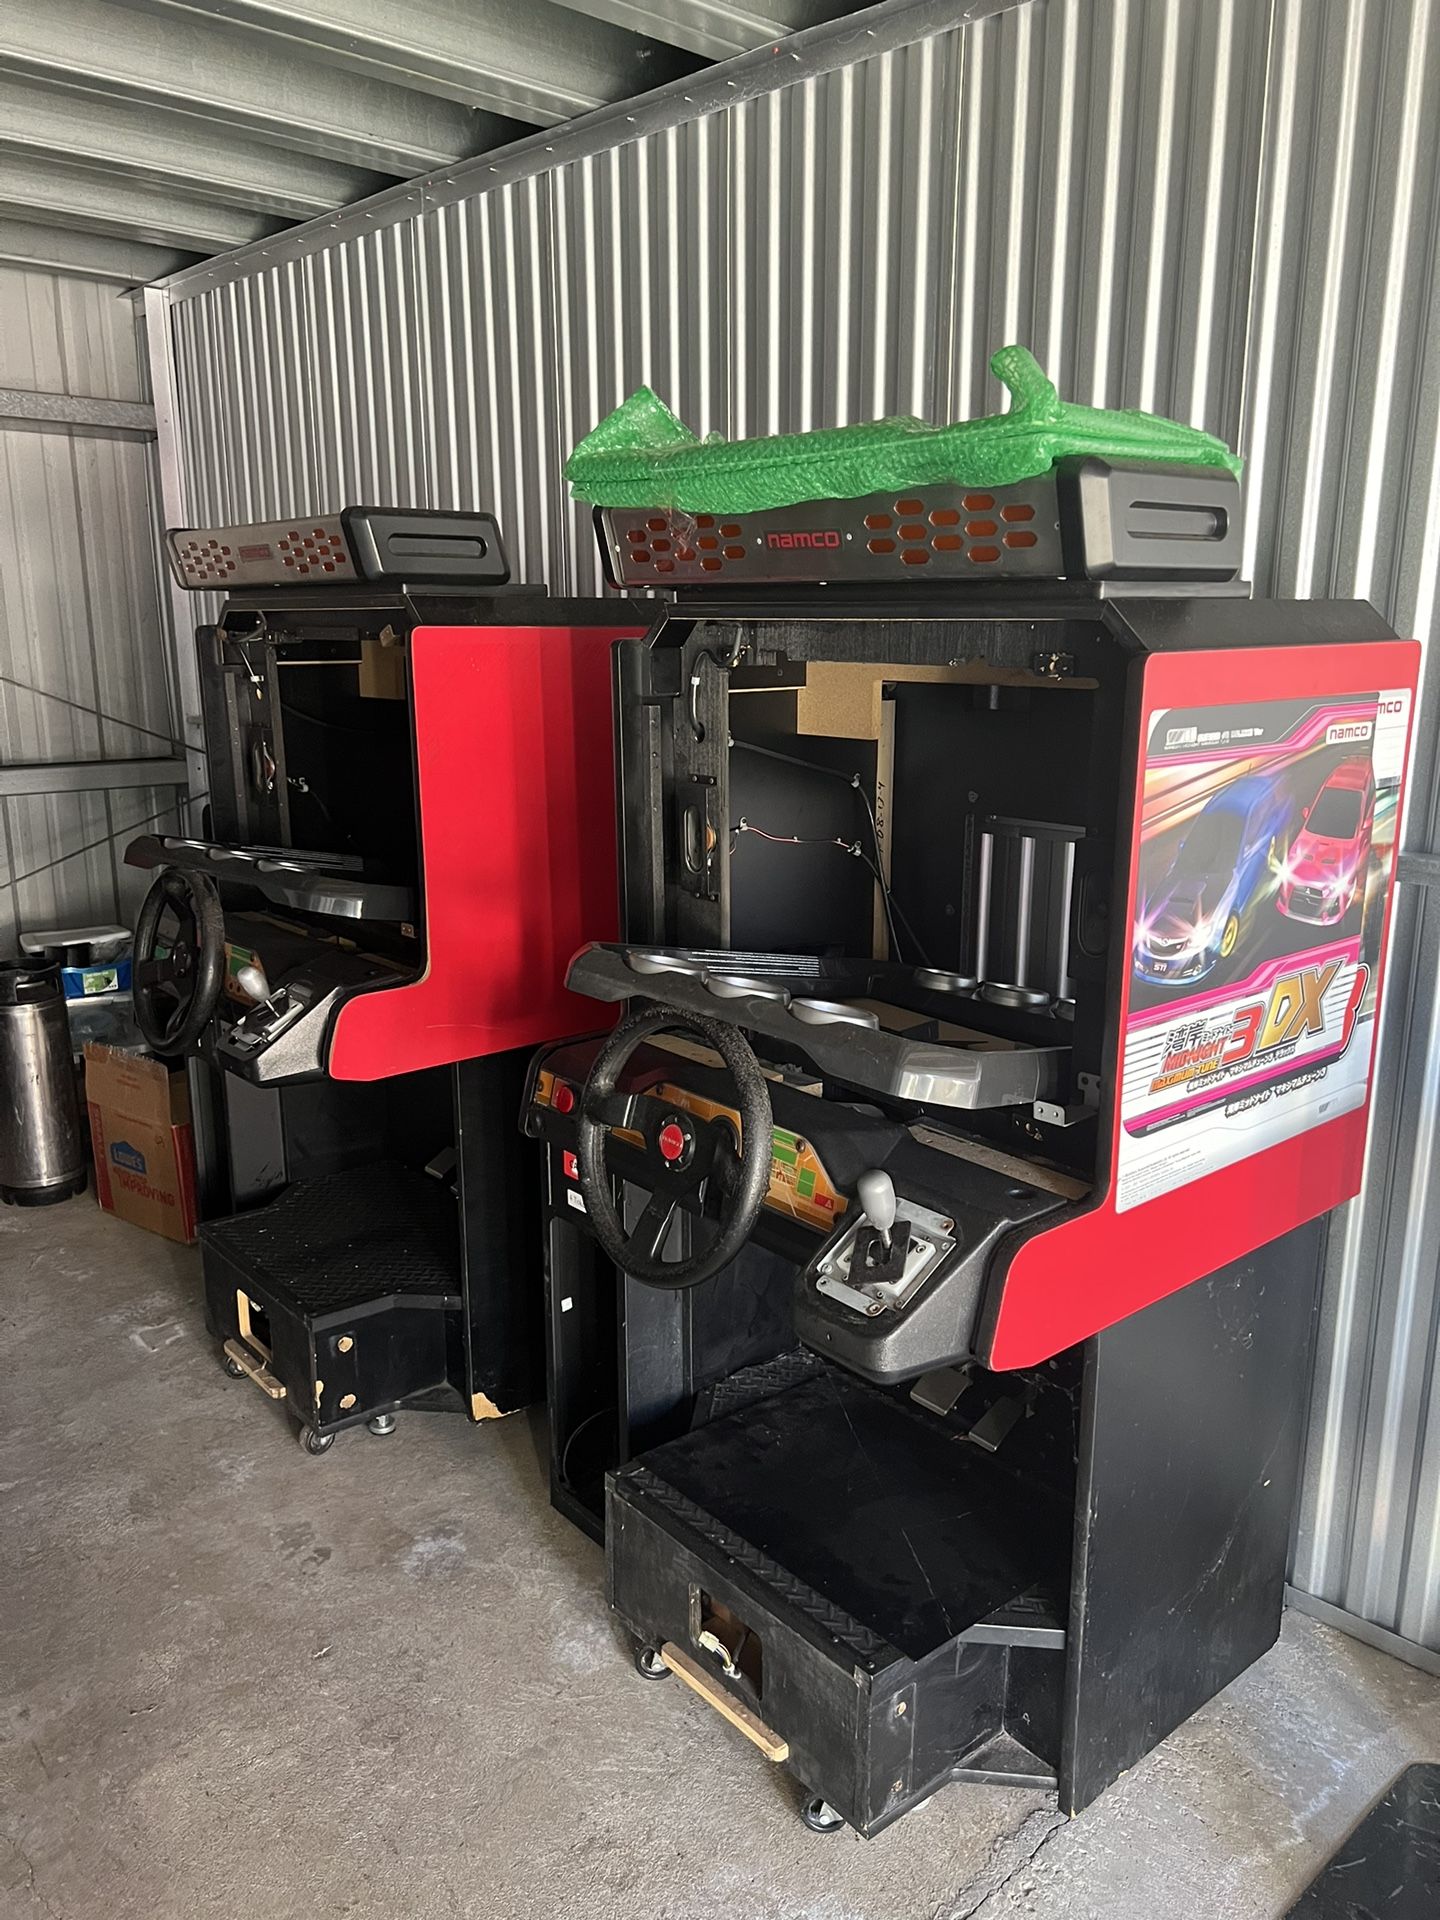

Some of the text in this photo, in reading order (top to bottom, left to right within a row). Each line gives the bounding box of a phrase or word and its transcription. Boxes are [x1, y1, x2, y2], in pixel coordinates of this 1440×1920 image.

[767, 531, 840, 549] namco
[1377, 700, 1402, 714] mco
[1329, 725, 1368, 740] namco
[1163, 1038, 1227, 1073] MIDNIGHT
